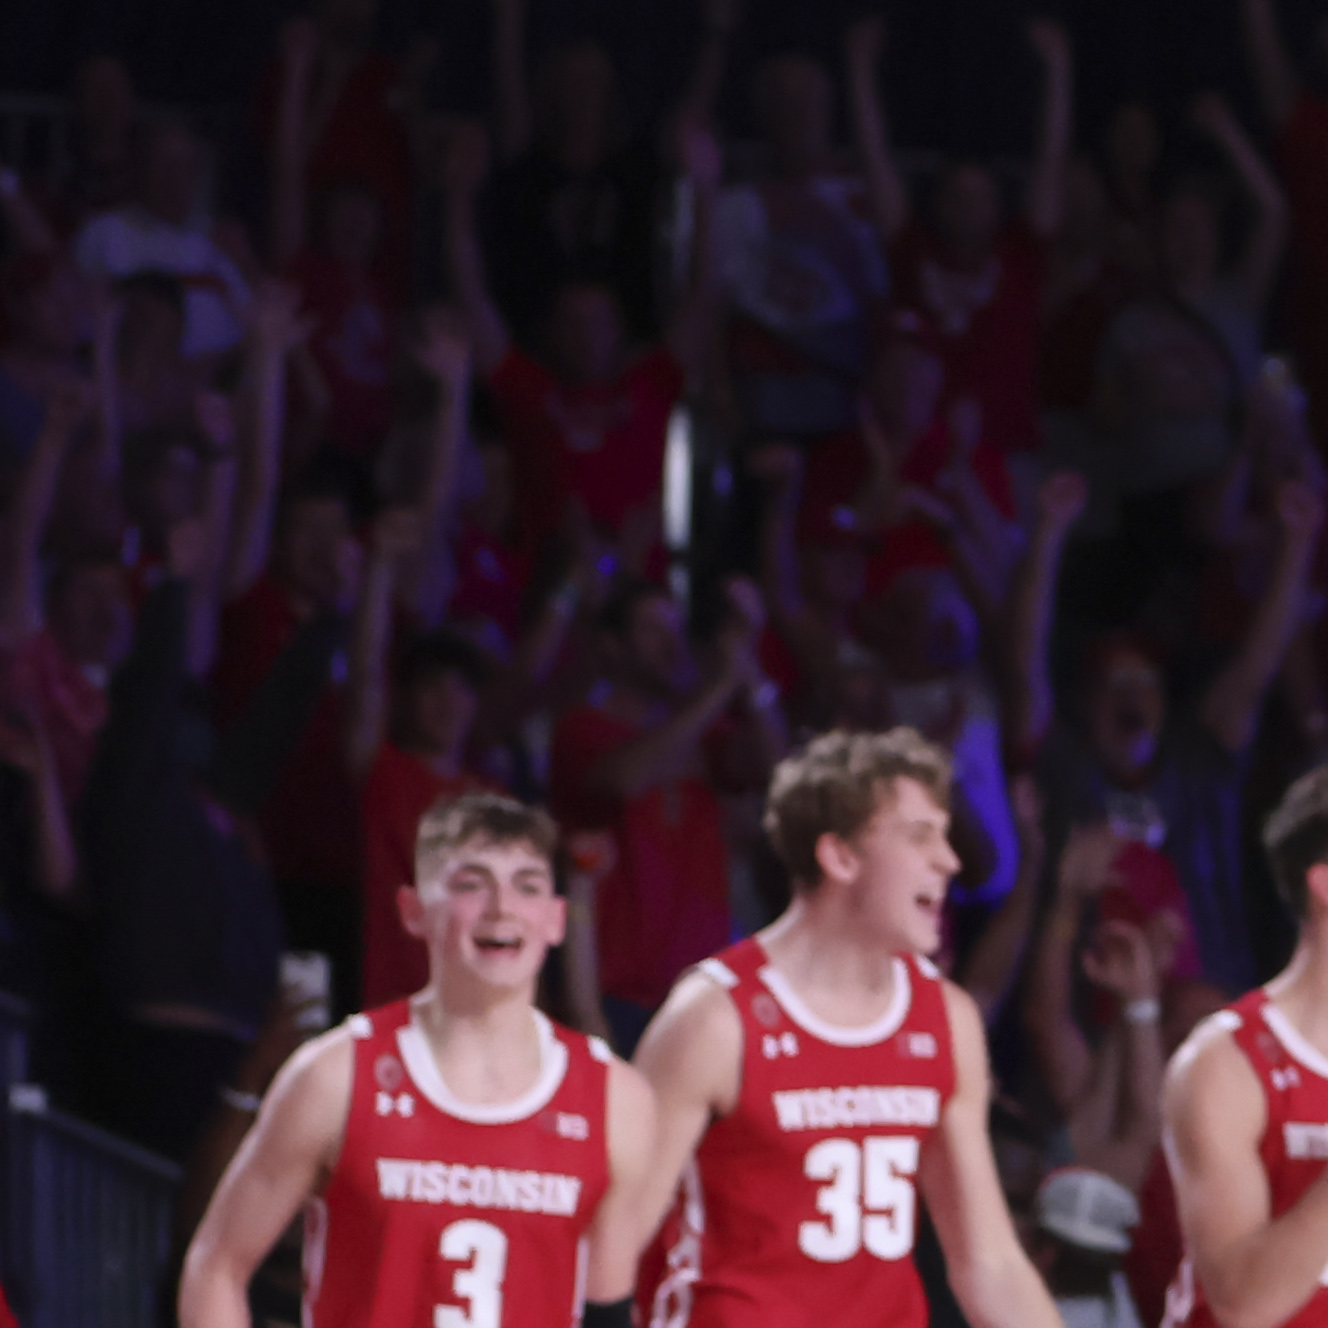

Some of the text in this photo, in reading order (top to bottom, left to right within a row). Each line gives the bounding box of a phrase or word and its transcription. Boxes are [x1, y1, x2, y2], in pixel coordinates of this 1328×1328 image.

[773, 1085, 941, 1132] WISCONSIN
[376, 1157, 582, 1217] WISCONSIN
[799, 1135, 920, 1262] 35
